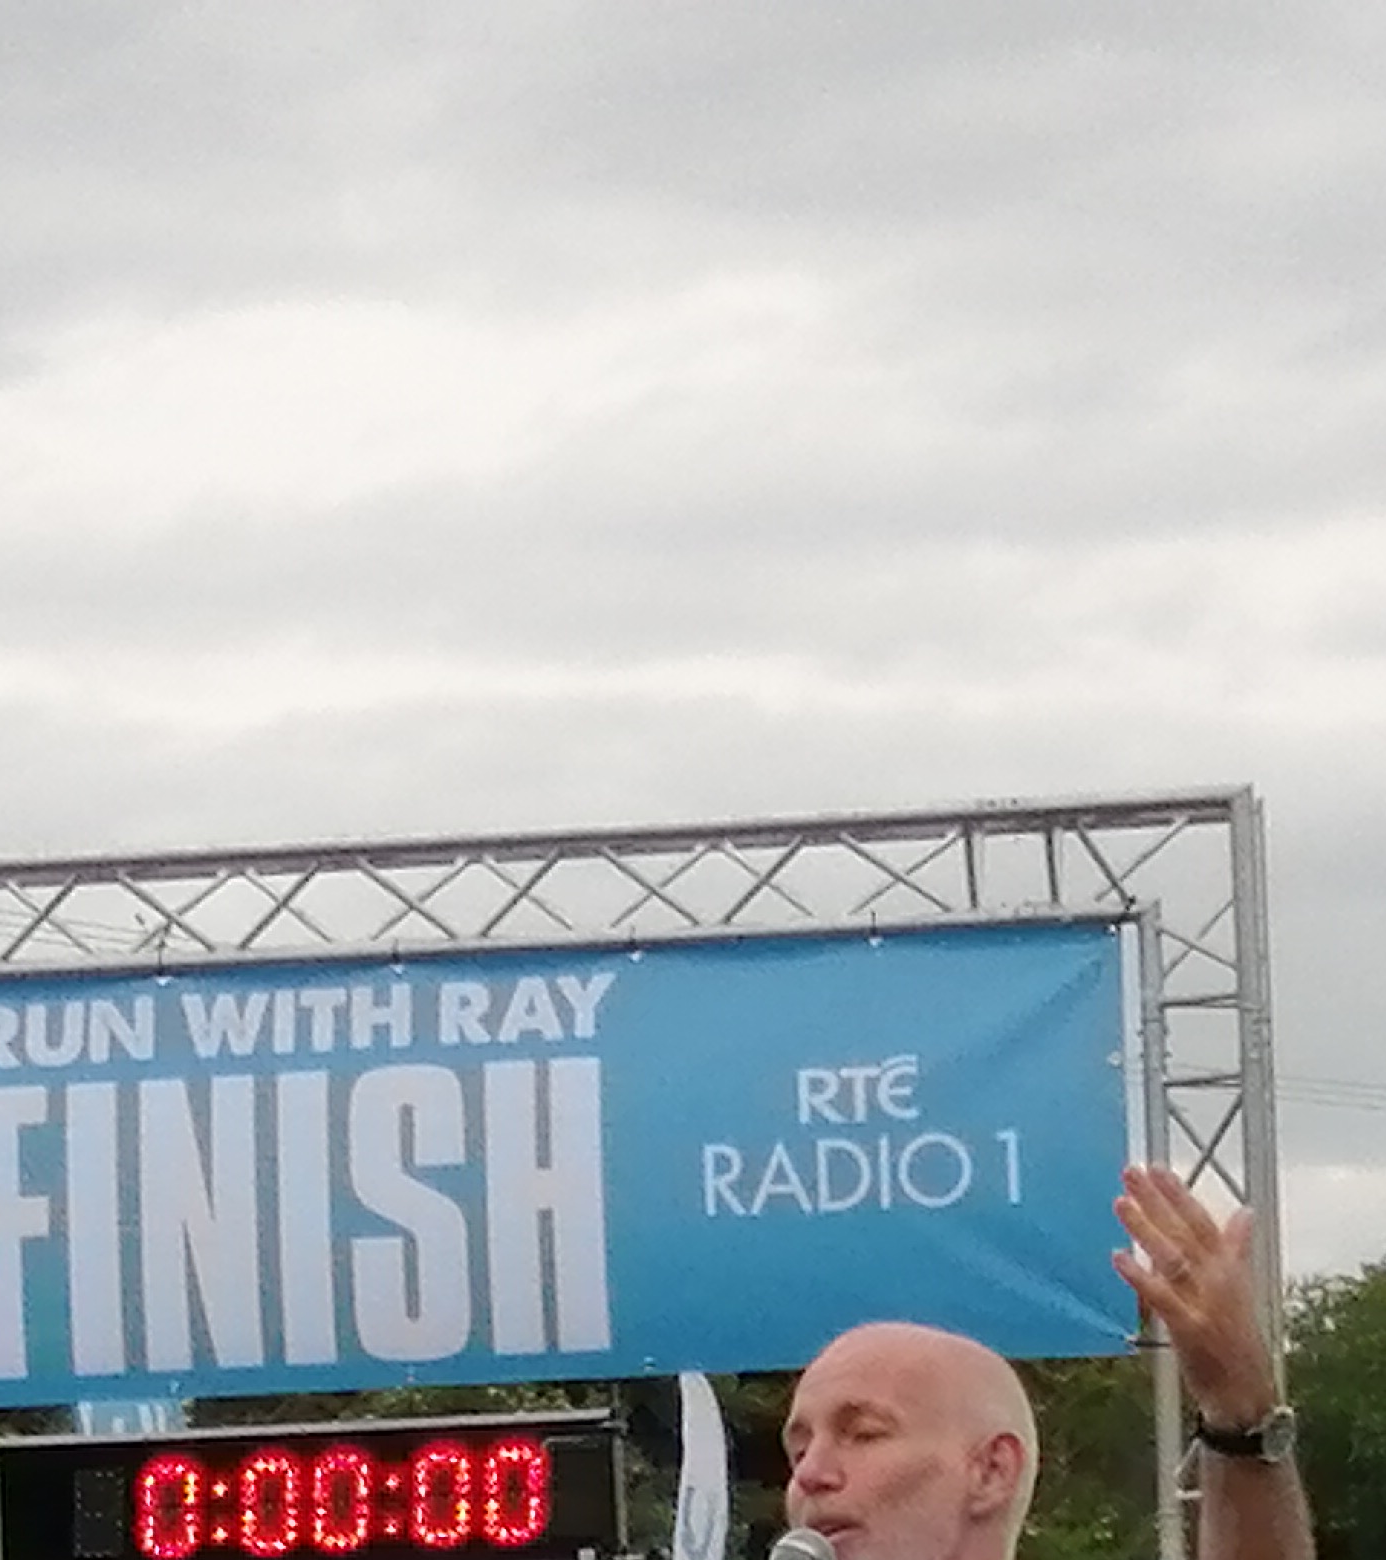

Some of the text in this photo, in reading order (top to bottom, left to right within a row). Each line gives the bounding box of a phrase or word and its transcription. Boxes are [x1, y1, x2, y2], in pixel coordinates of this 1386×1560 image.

[180, 981, 412, 1061] WITH
[438, 972, 616, 1046] RAY
[702, 1128, 1021, 1217] RADIO 1
